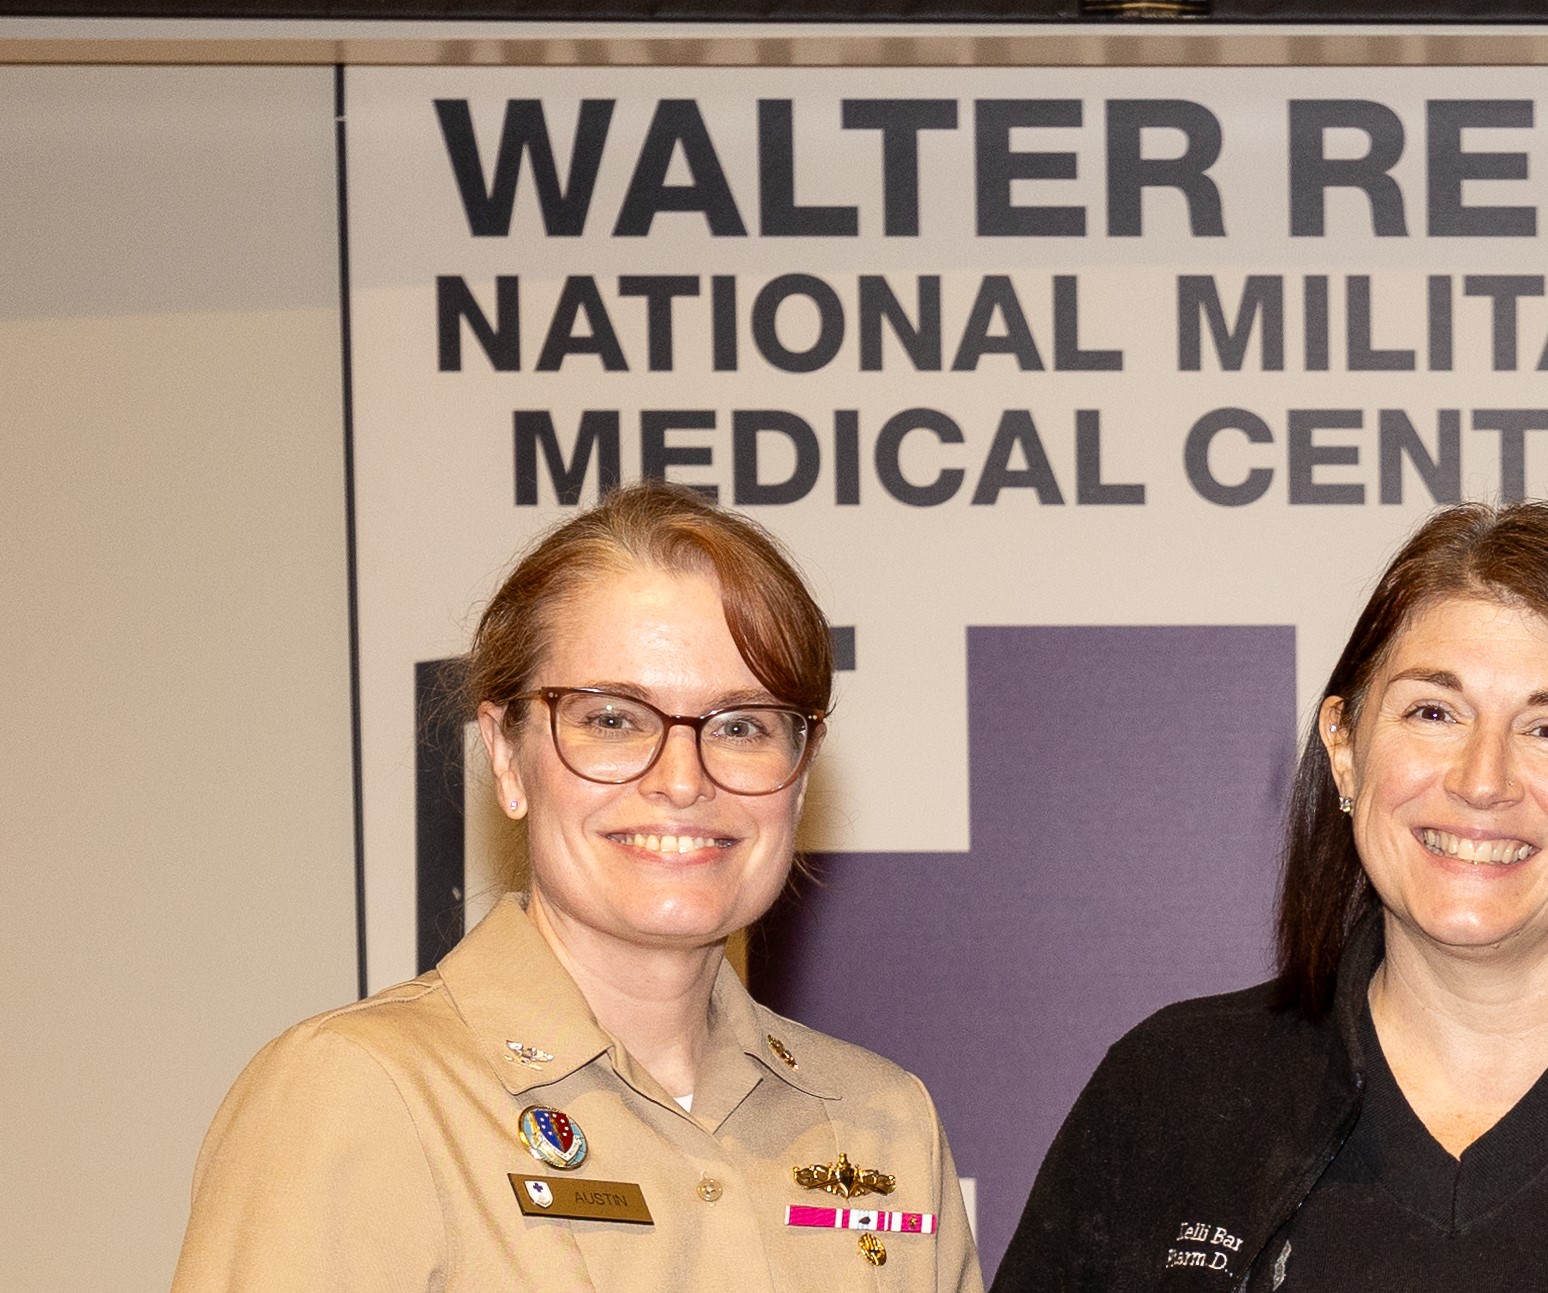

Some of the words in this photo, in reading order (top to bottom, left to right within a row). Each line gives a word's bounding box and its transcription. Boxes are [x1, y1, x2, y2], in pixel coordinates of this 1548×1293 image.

[432, 98, 1226, 237] WALTER
[434, 273, 1123, 374] NATIONAL
[512, 408, 1145, 507] MEDICAL
[575, 1191, 628, 1207] AUSTIN
